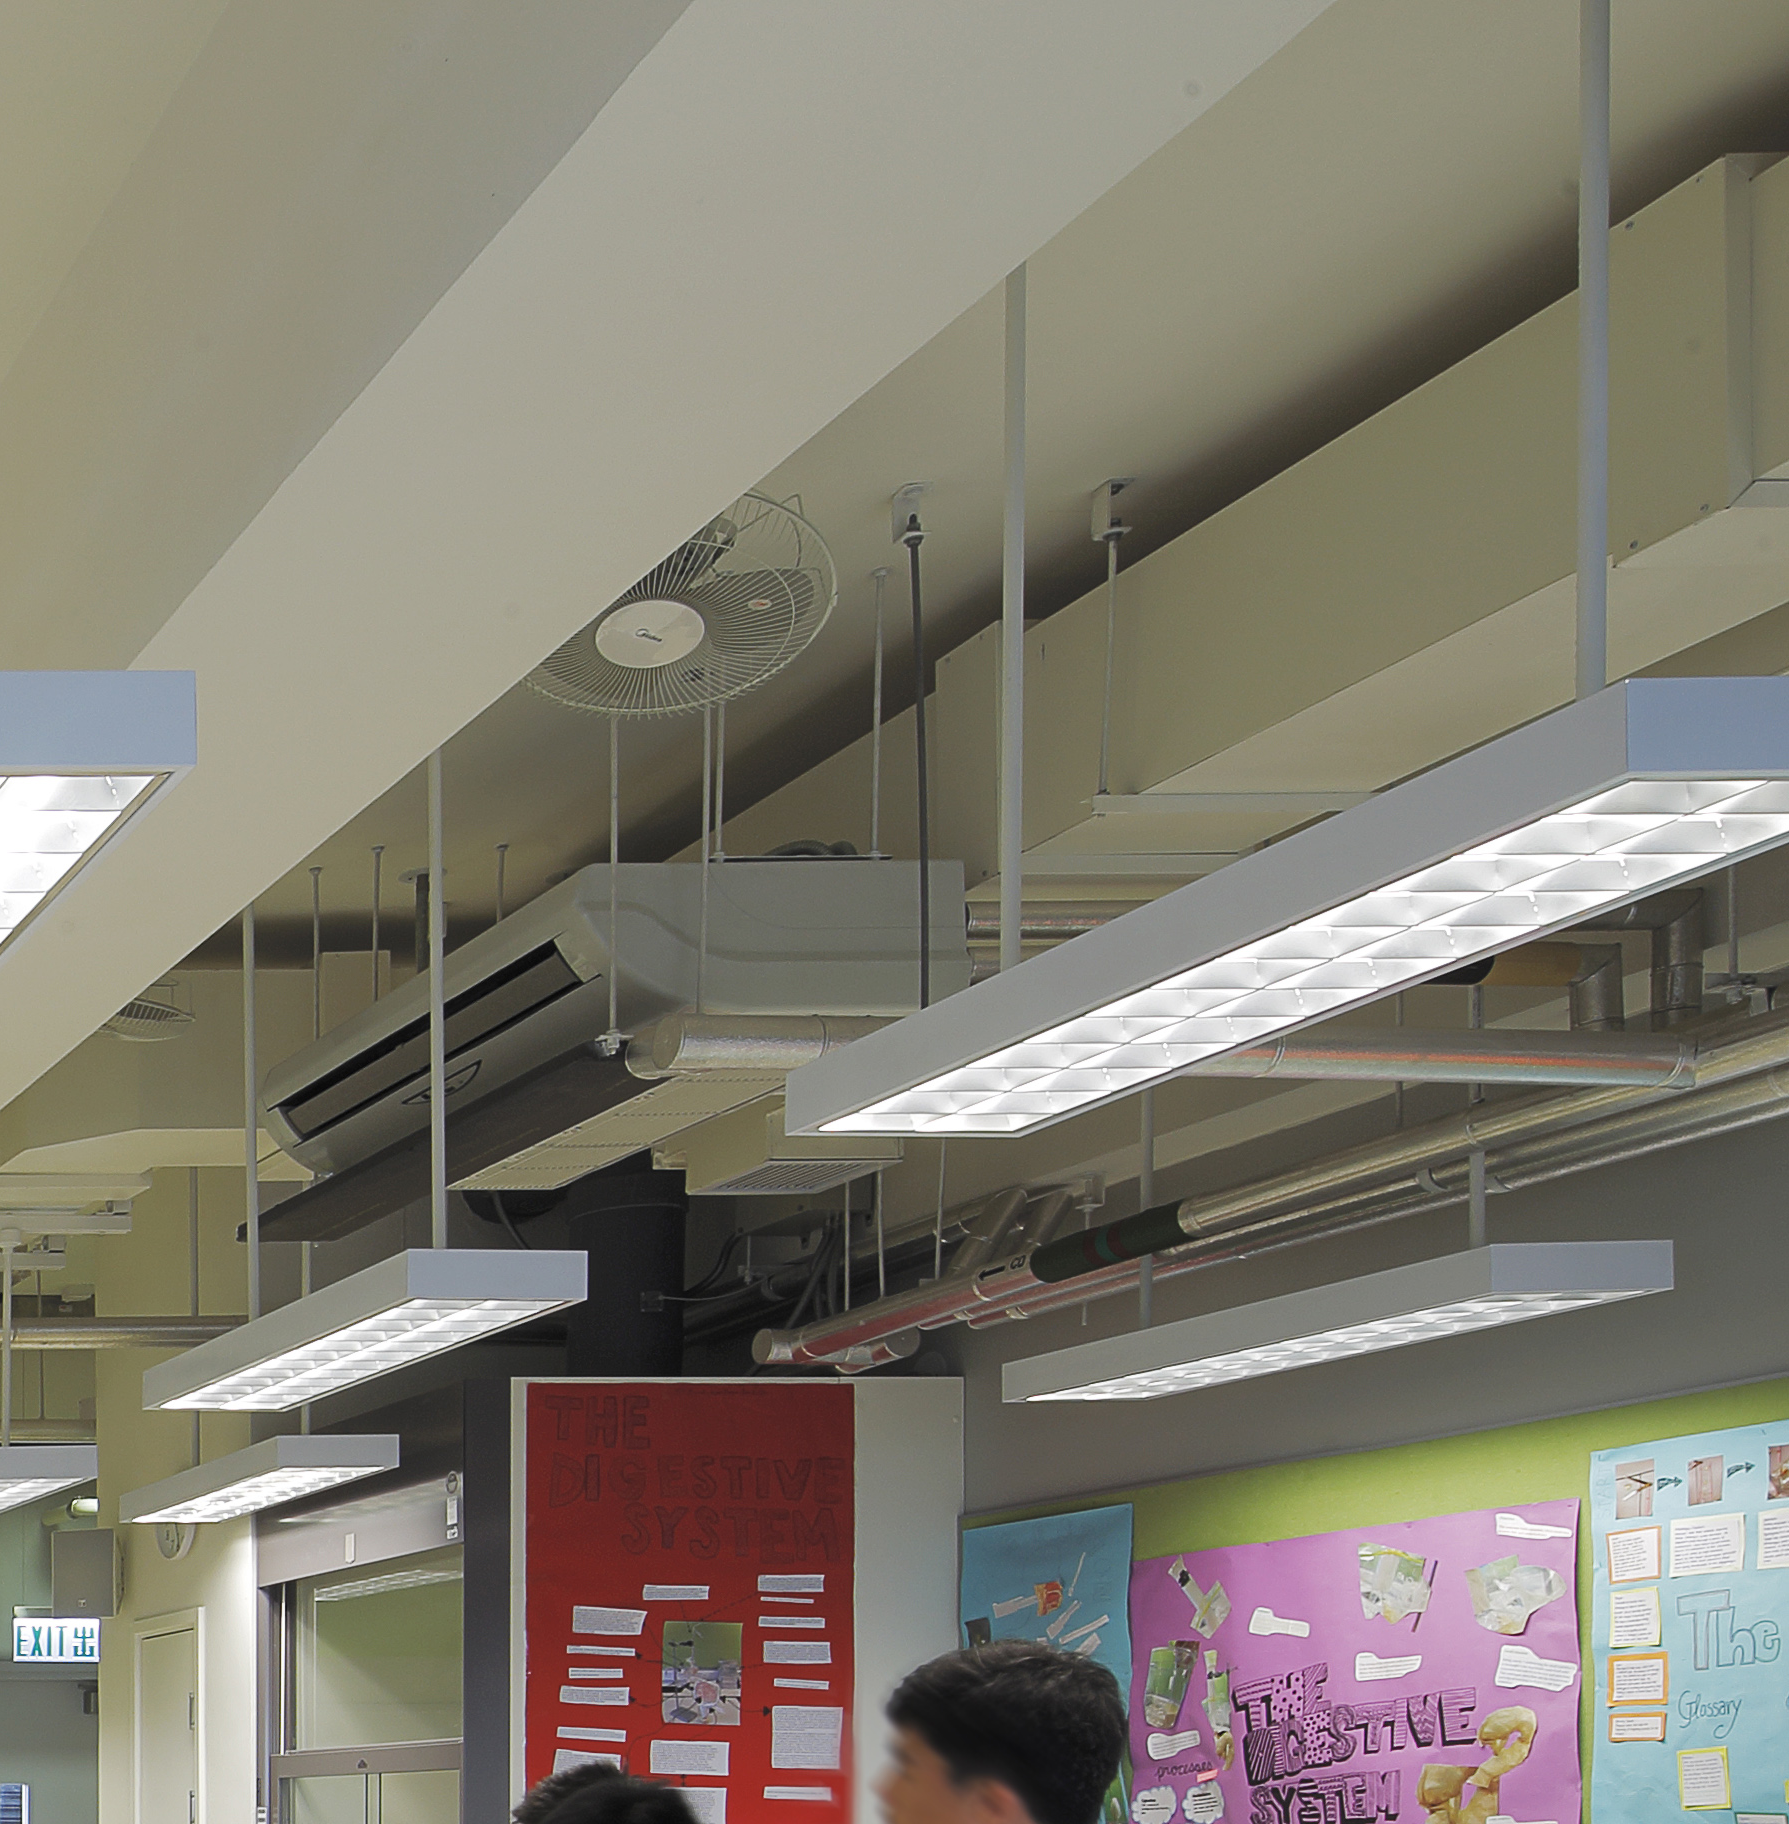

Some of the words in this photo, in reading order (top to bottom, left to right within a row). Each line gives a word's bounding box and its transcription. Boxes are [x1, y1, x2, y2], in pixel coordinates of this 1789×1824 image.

[544, 1395, 651, 1450] THE
[549, 1452, 846, 1508] DIGESTIVE
[621, 1502, 841, 1564] SYSTEM
[16, 1625, 68, 1657] EXIT
[1676, 1589, 1781, 1671] The
[1232, 1662, 1329, 1731] THE
[1677, 1690, 1743, 1740] Glossary
[1243, 1687, 1478, 1786] DIGESTIVE
